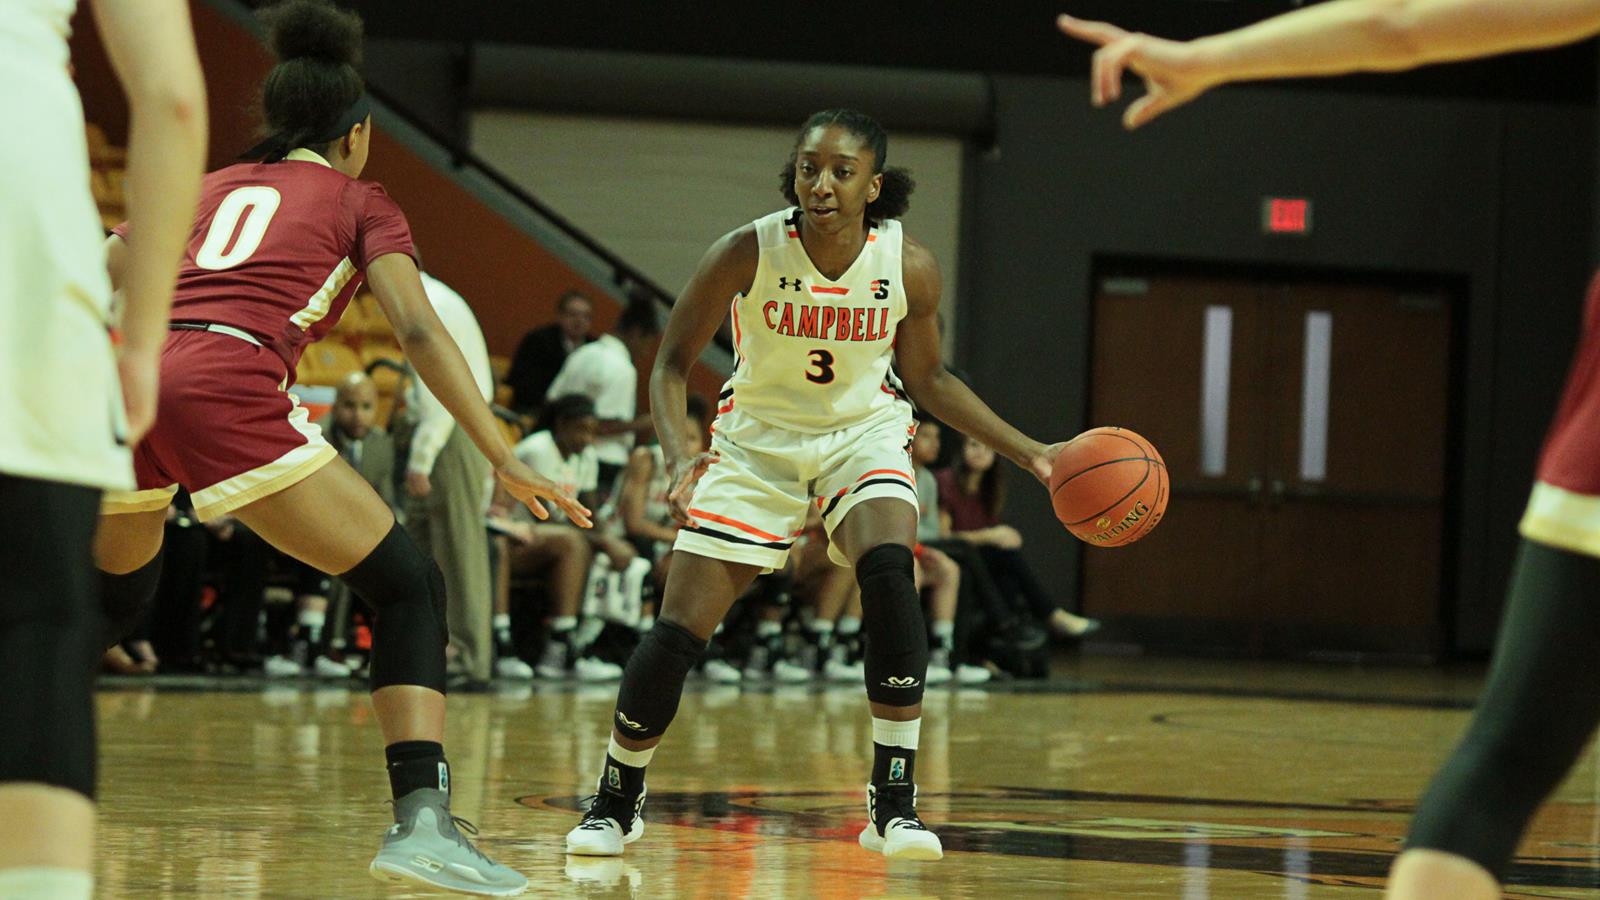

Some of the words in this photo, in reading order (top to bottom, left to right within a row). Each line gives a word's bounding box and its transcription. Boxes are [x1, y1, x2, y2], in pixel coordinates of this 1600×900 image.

[196, 186, 281, 271] 0
[763, 301, 889, 341] CAMPBELL
[805, 350, 835, 384] 3
[1093, 500, 1149, 541] ALDING
